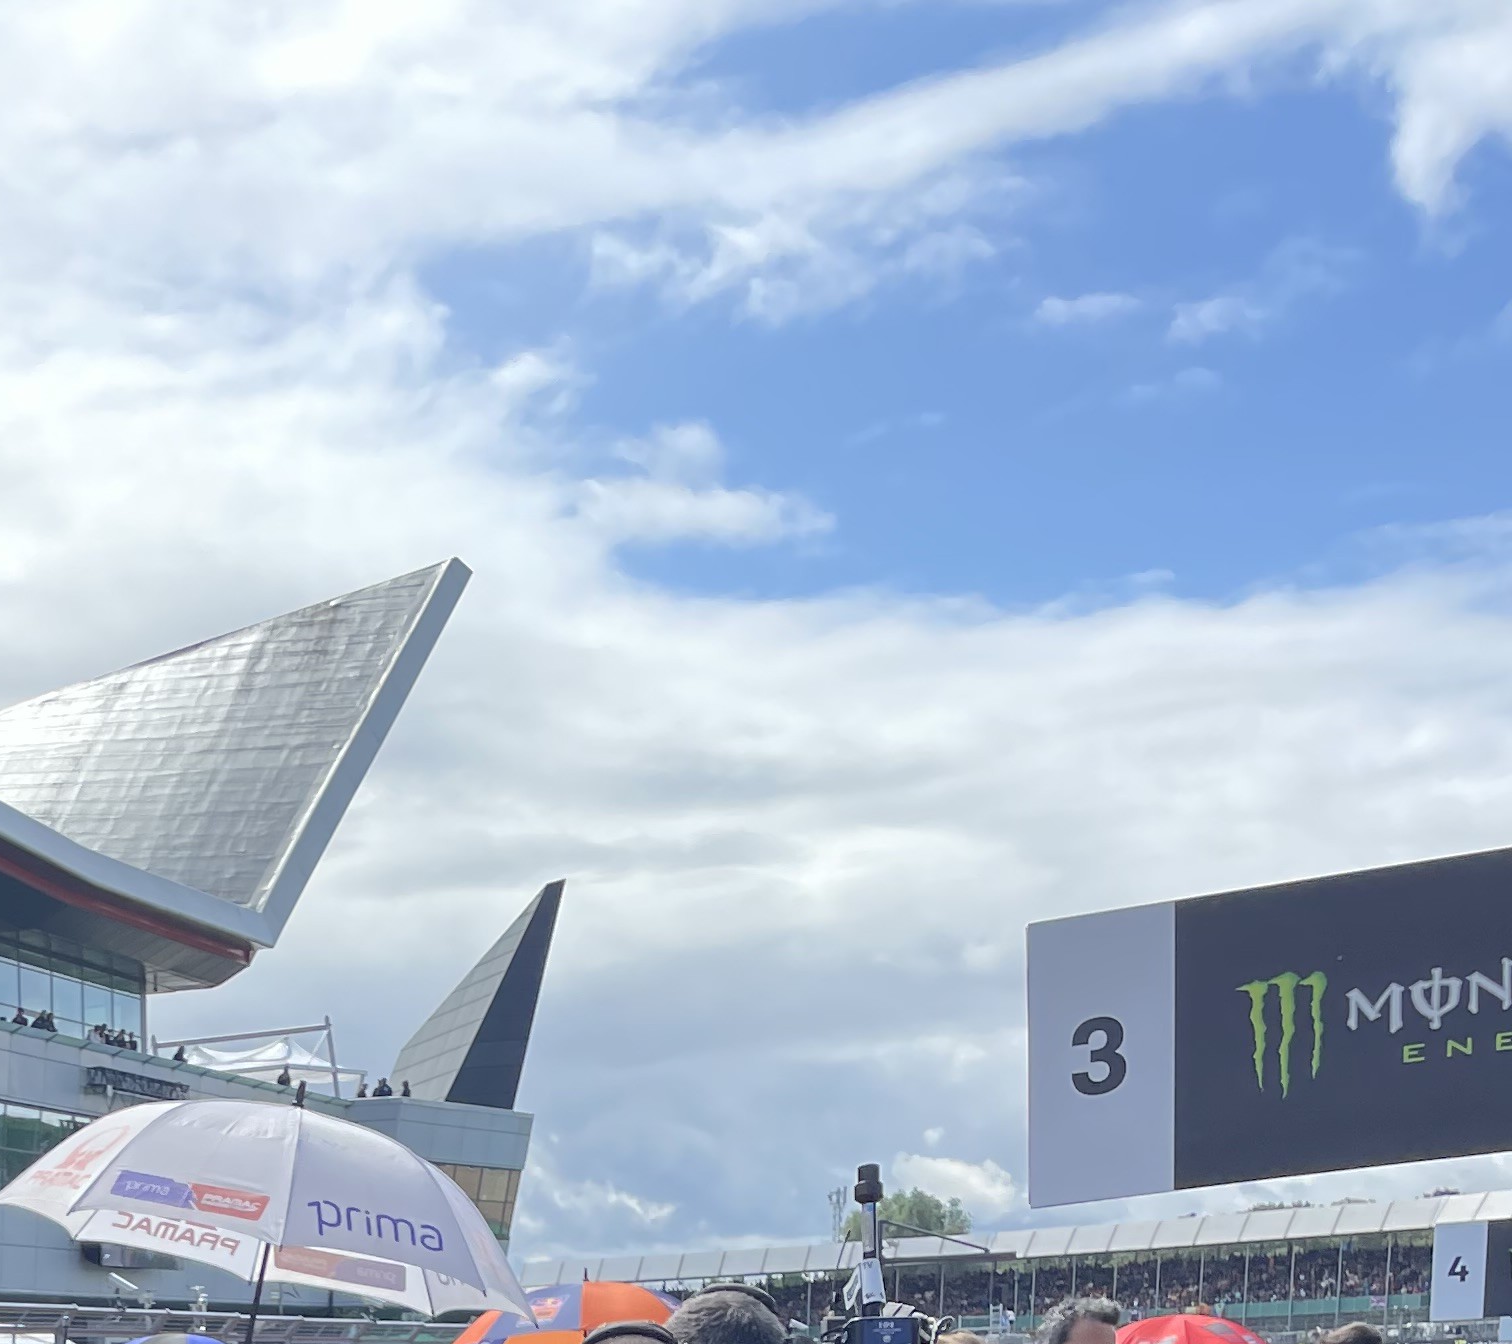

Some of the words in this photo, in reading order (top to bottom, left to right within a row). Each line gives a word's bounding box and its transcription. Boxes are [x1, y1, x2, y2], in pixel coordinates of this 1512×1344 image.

[1071, 1016, 1127, 1096] 3
[307, 1199, 444, 1252] prima
[1447, 1256, 1469, 1282] 4
